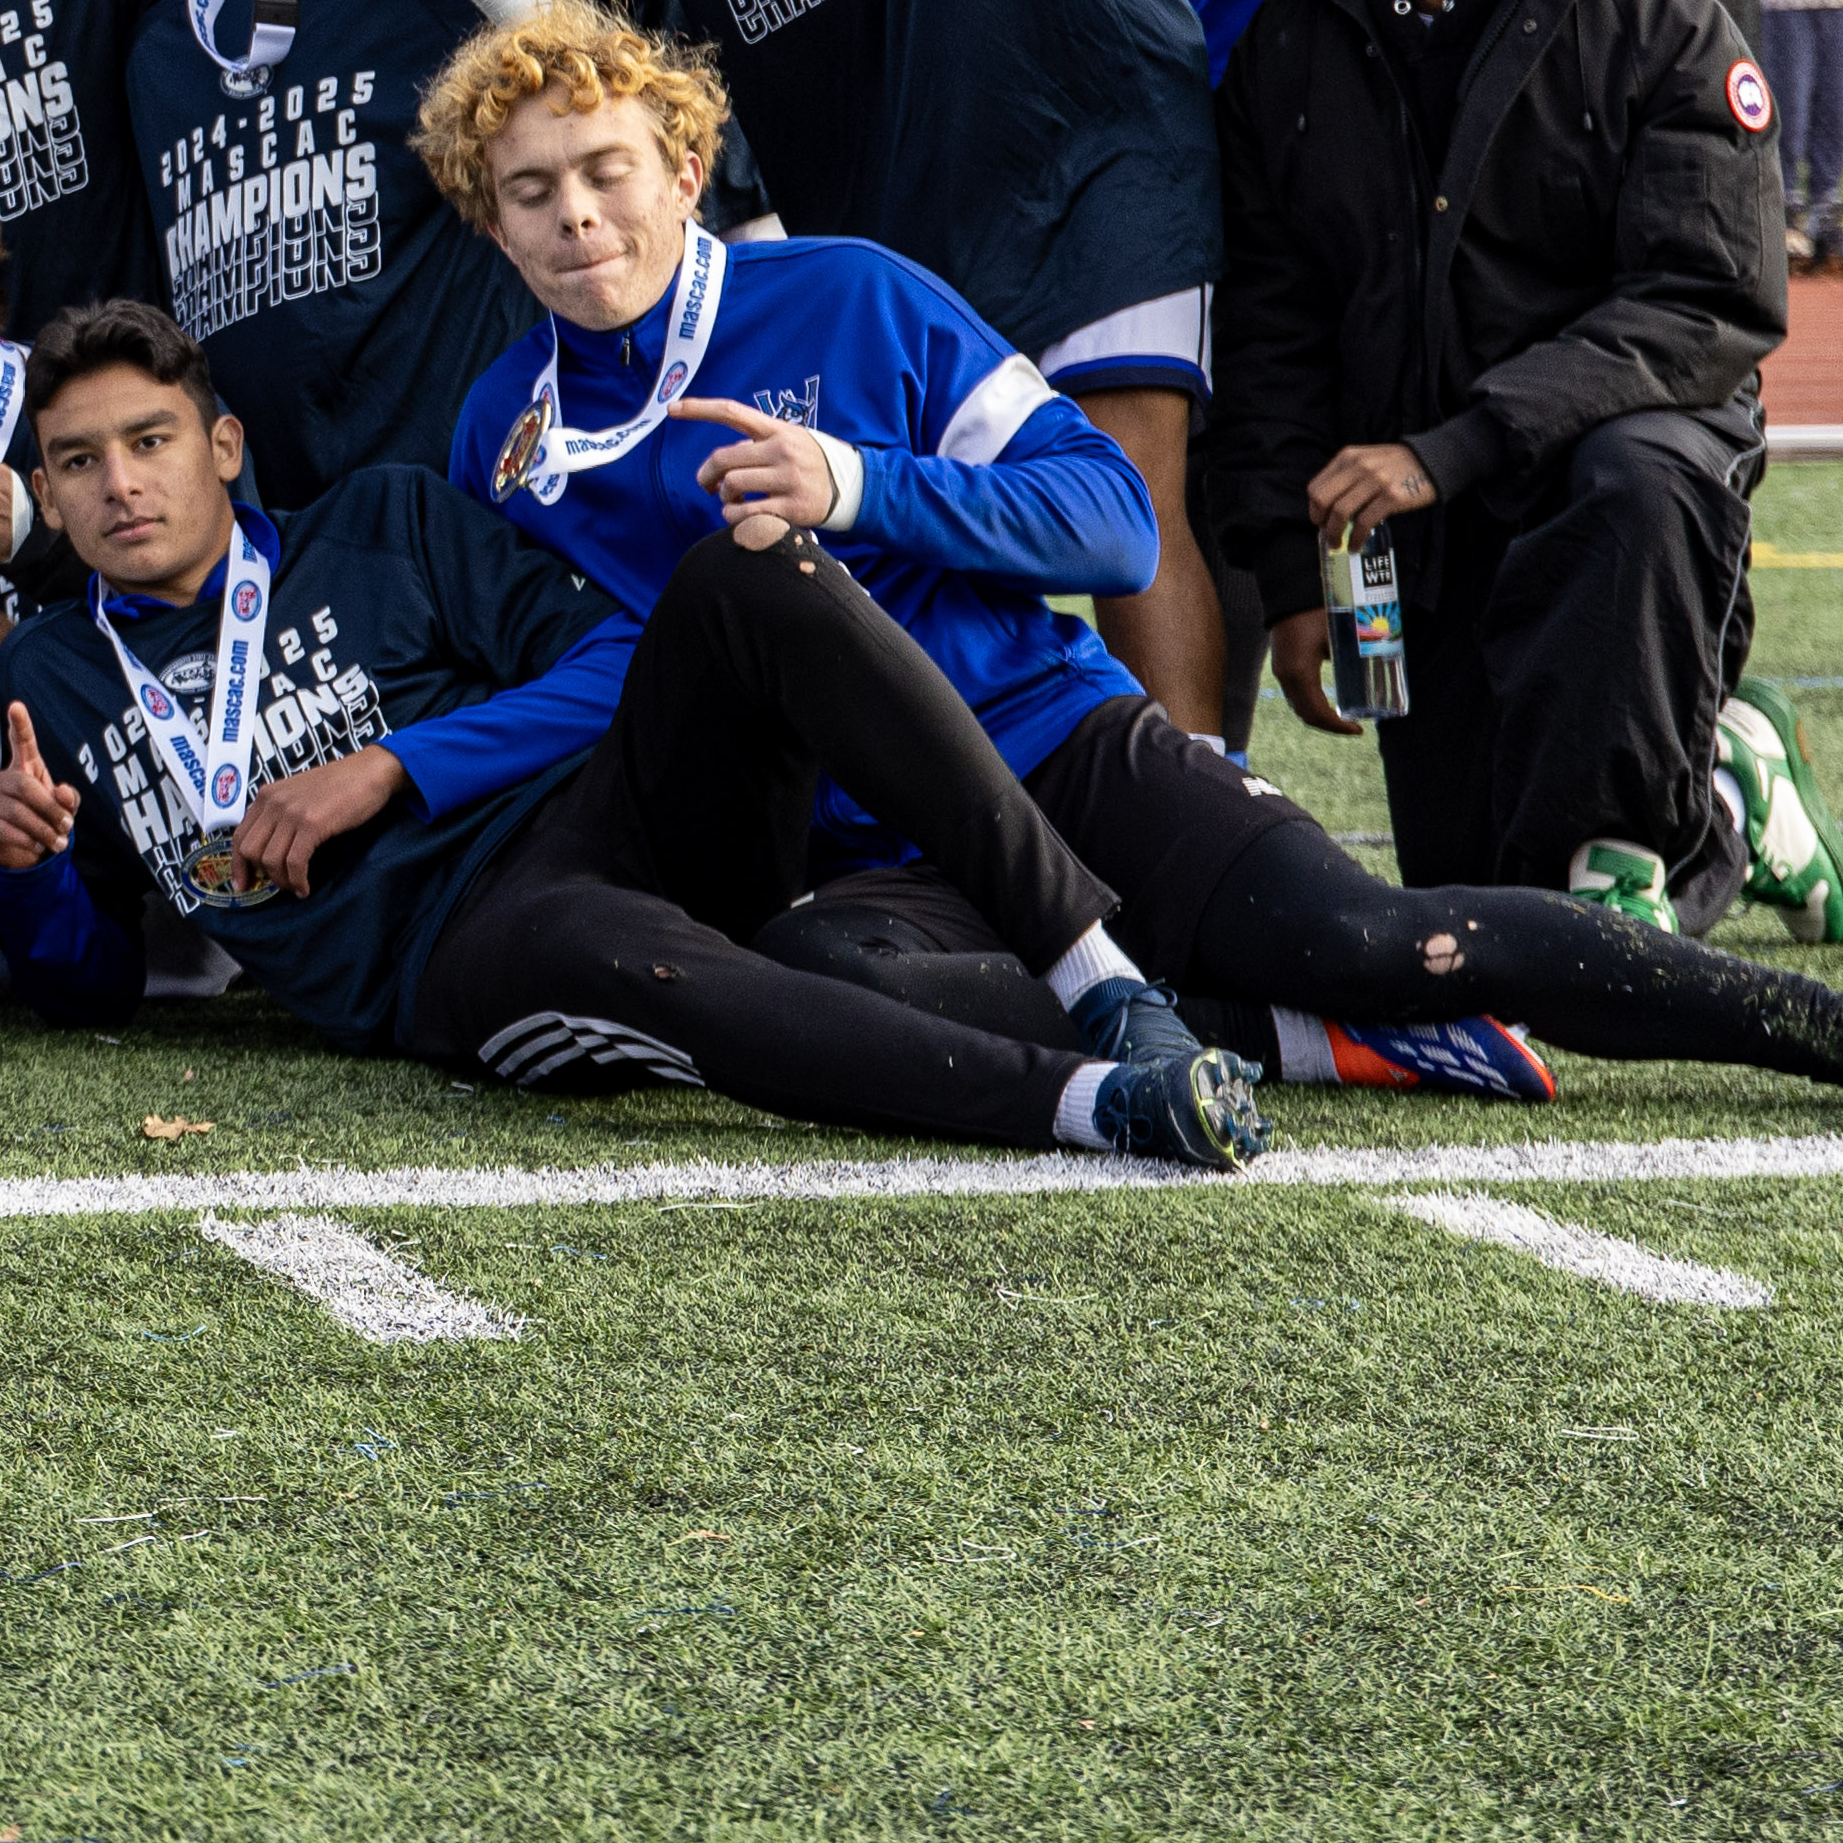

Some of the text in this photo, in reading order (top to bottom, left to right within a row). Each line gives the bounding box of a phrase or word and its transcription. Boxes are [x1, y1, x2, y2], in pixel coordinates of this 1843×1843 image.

[160, 71, 375, 187] 2024-2025
[176, 109, 357, 210] MASCAC
[166, 142, 377, 281] CHAMPIONS
[678, 236, 719, 340] mascac.com
[1364, 556, 1390, 571] LIFE
[222, 640, 250, 743] mascac.com
